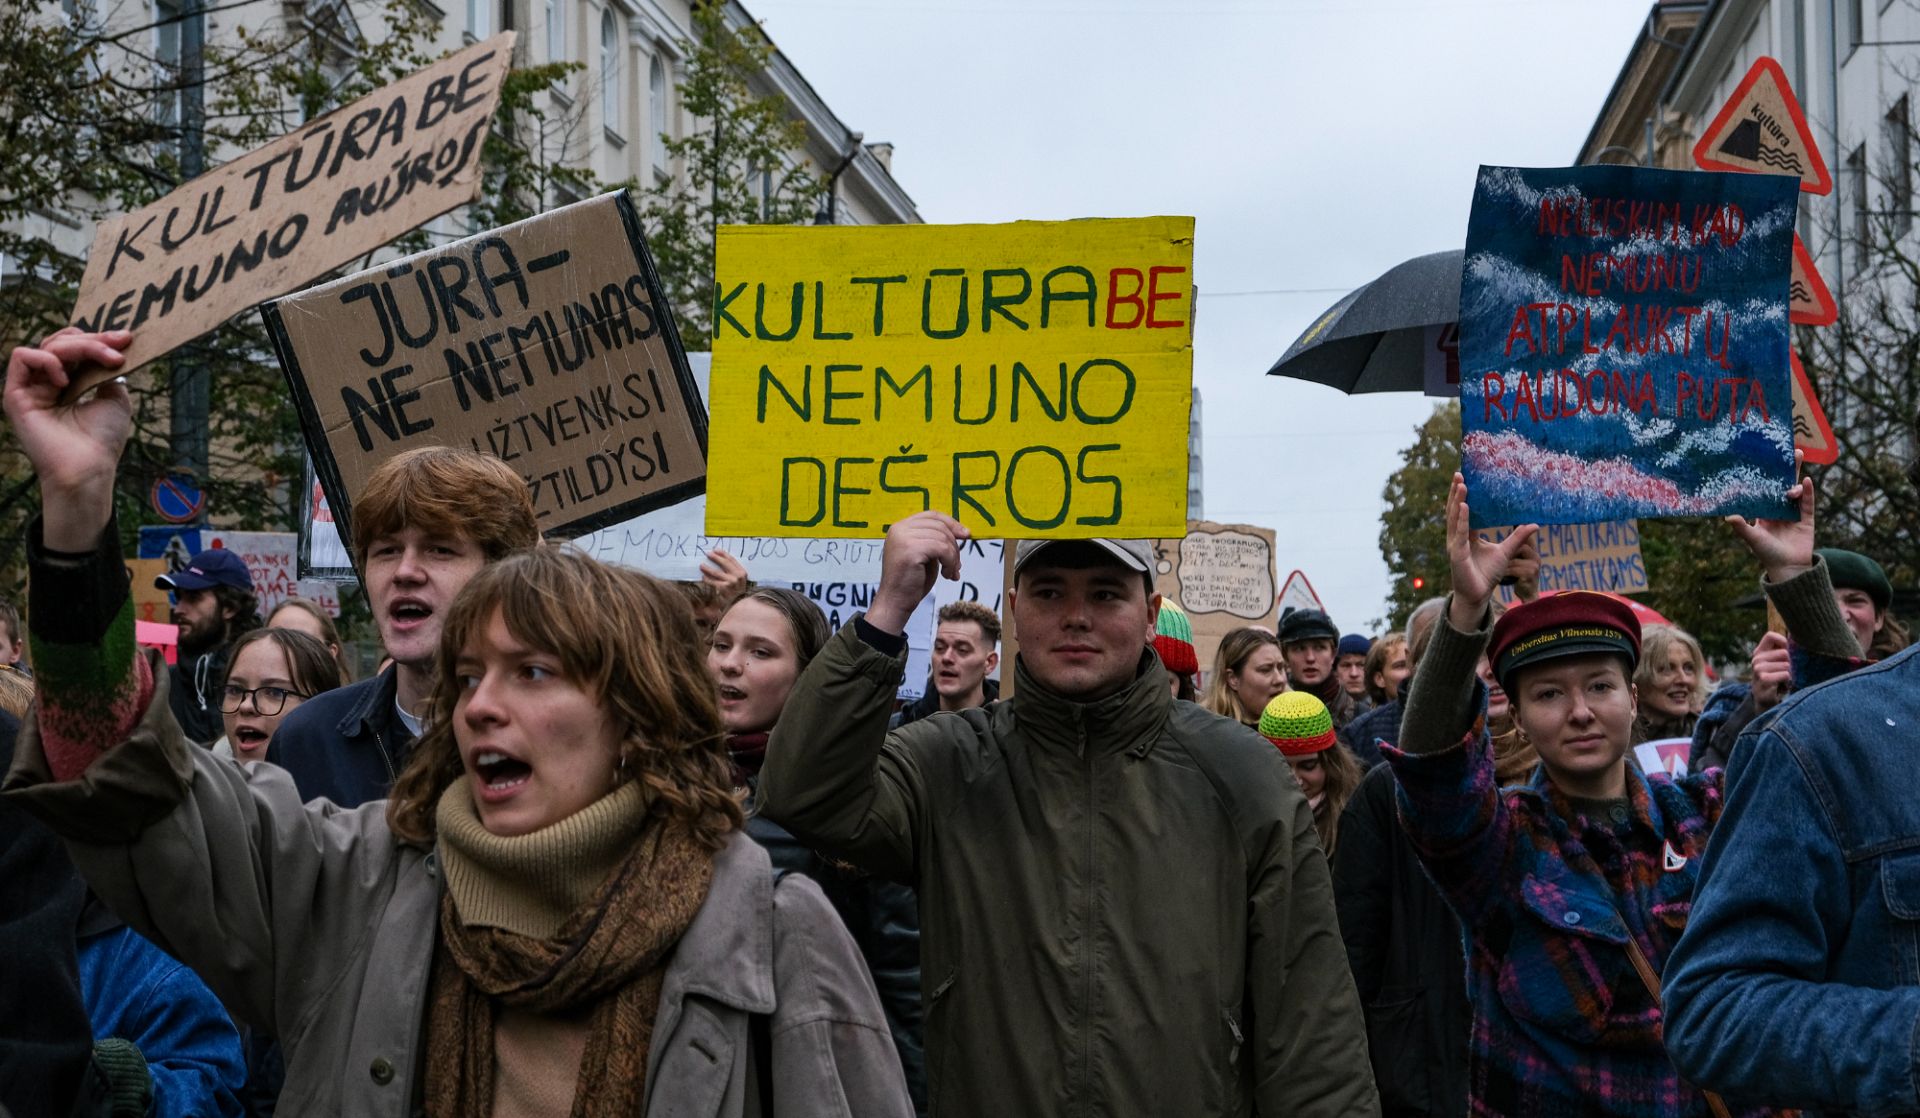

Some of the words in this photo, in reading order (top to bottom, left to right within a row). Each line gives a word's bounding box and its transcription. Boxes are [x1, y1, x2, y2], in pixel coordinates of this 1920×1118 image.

[1750, 103, 1790, 148] kultūra
[105, 95, 407, 281] KULTŪRA
[415, 50, 497, 131] BE
[1537, 196, 1681, 246] NELEISKIM
[1691, 202, 1744, 248] KAD
[75, 213, 309, 333] NEMUNO
[712, 265, 1097, 342] KULTŪRA
[1105, 266, 1187, 331] BE
[1561, 253, 1702, 297] NEMUNU
[340, 364, 434, 452] NE
[444, 274, 661, 412] NEMUNAS
[756, 358, 1137, 426] NEMUNO
[1482, 369, 1660, 424] RAUDONA
[1676, 370, 1771, 425] PUTA
[524, 430, 670, 519] ŽTILDYSI
[779, 442, 1122, 533] DEŠROS
[248, 568, 271, 581] OT
[276, 567, 290, 581] A
[254, 582, 298, 597] AME
[1510, 632, 1558, 657] Universitas
